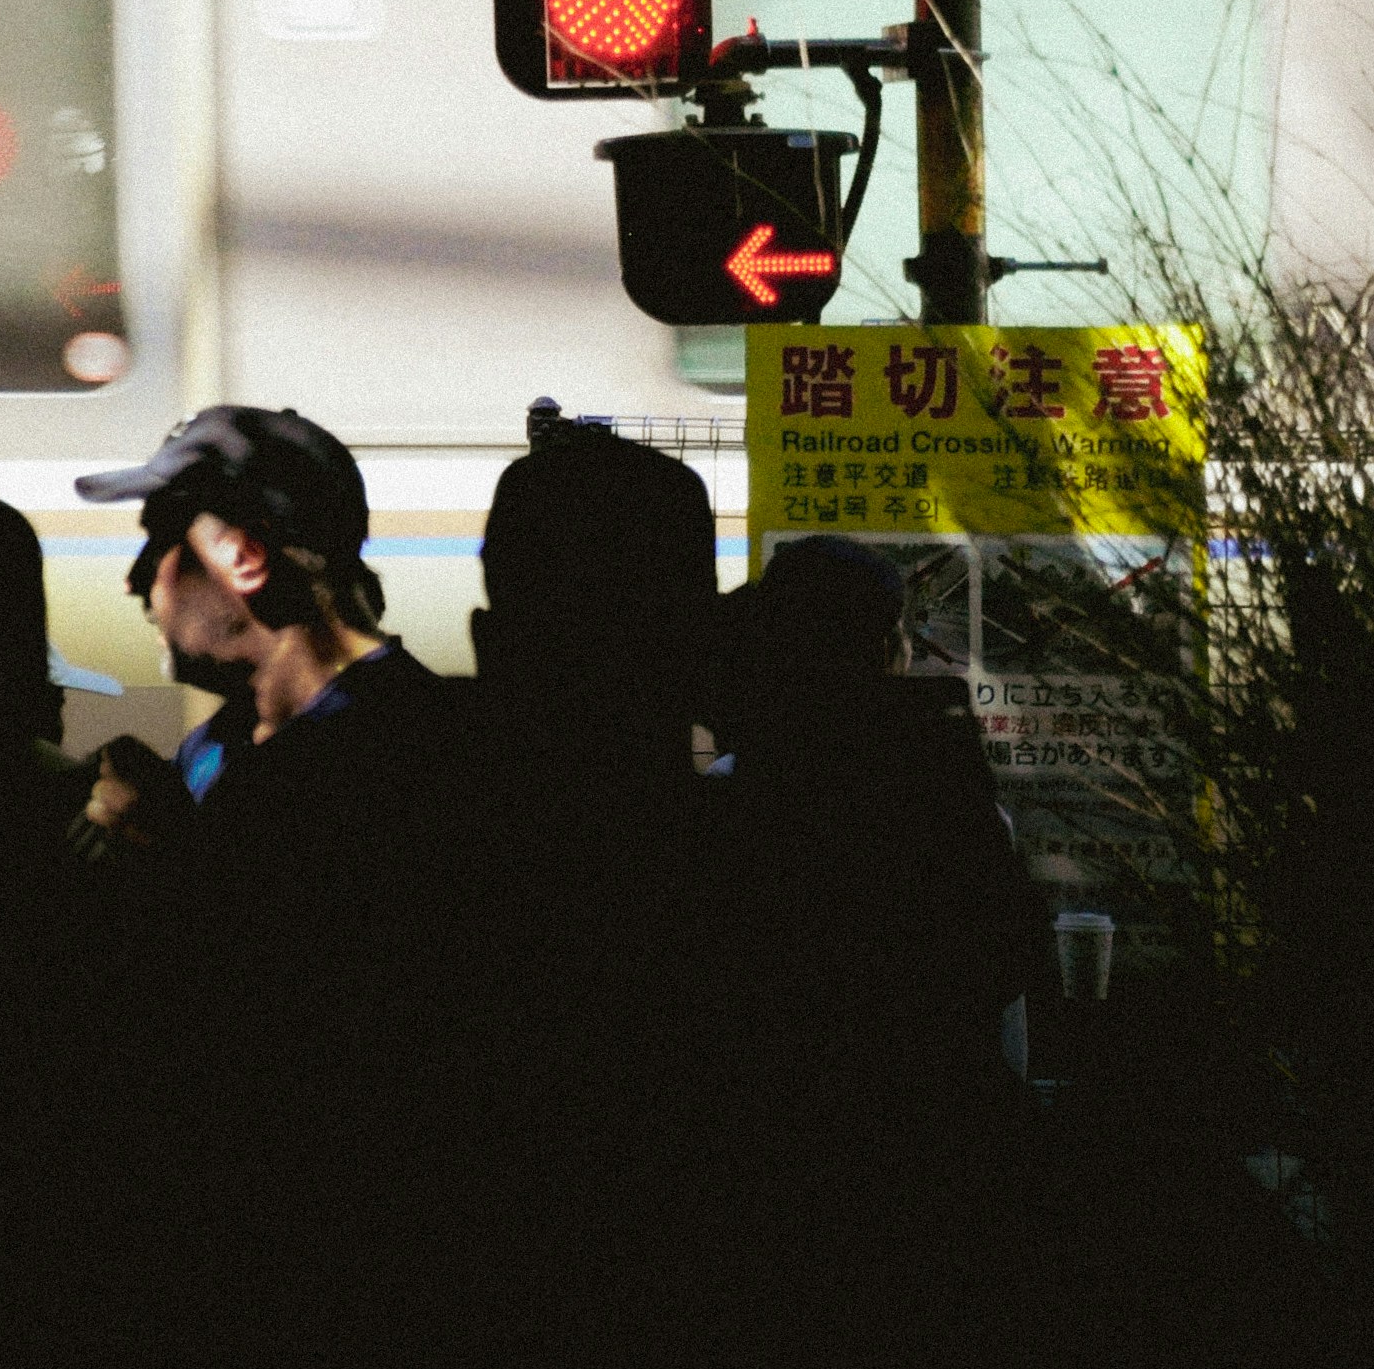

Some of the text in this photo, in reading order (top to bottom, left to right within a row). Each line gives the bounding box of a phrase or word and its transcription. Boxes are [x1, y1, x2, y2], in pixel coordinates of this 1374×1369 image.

[780, 344, 1170, 420] 踏切注意
[782, 430, 1170, 461] Railroad Crossing Warning
[783, 463, 928, 489] 注意平交道
[784, 495, 938, 522] 건널목 주의
